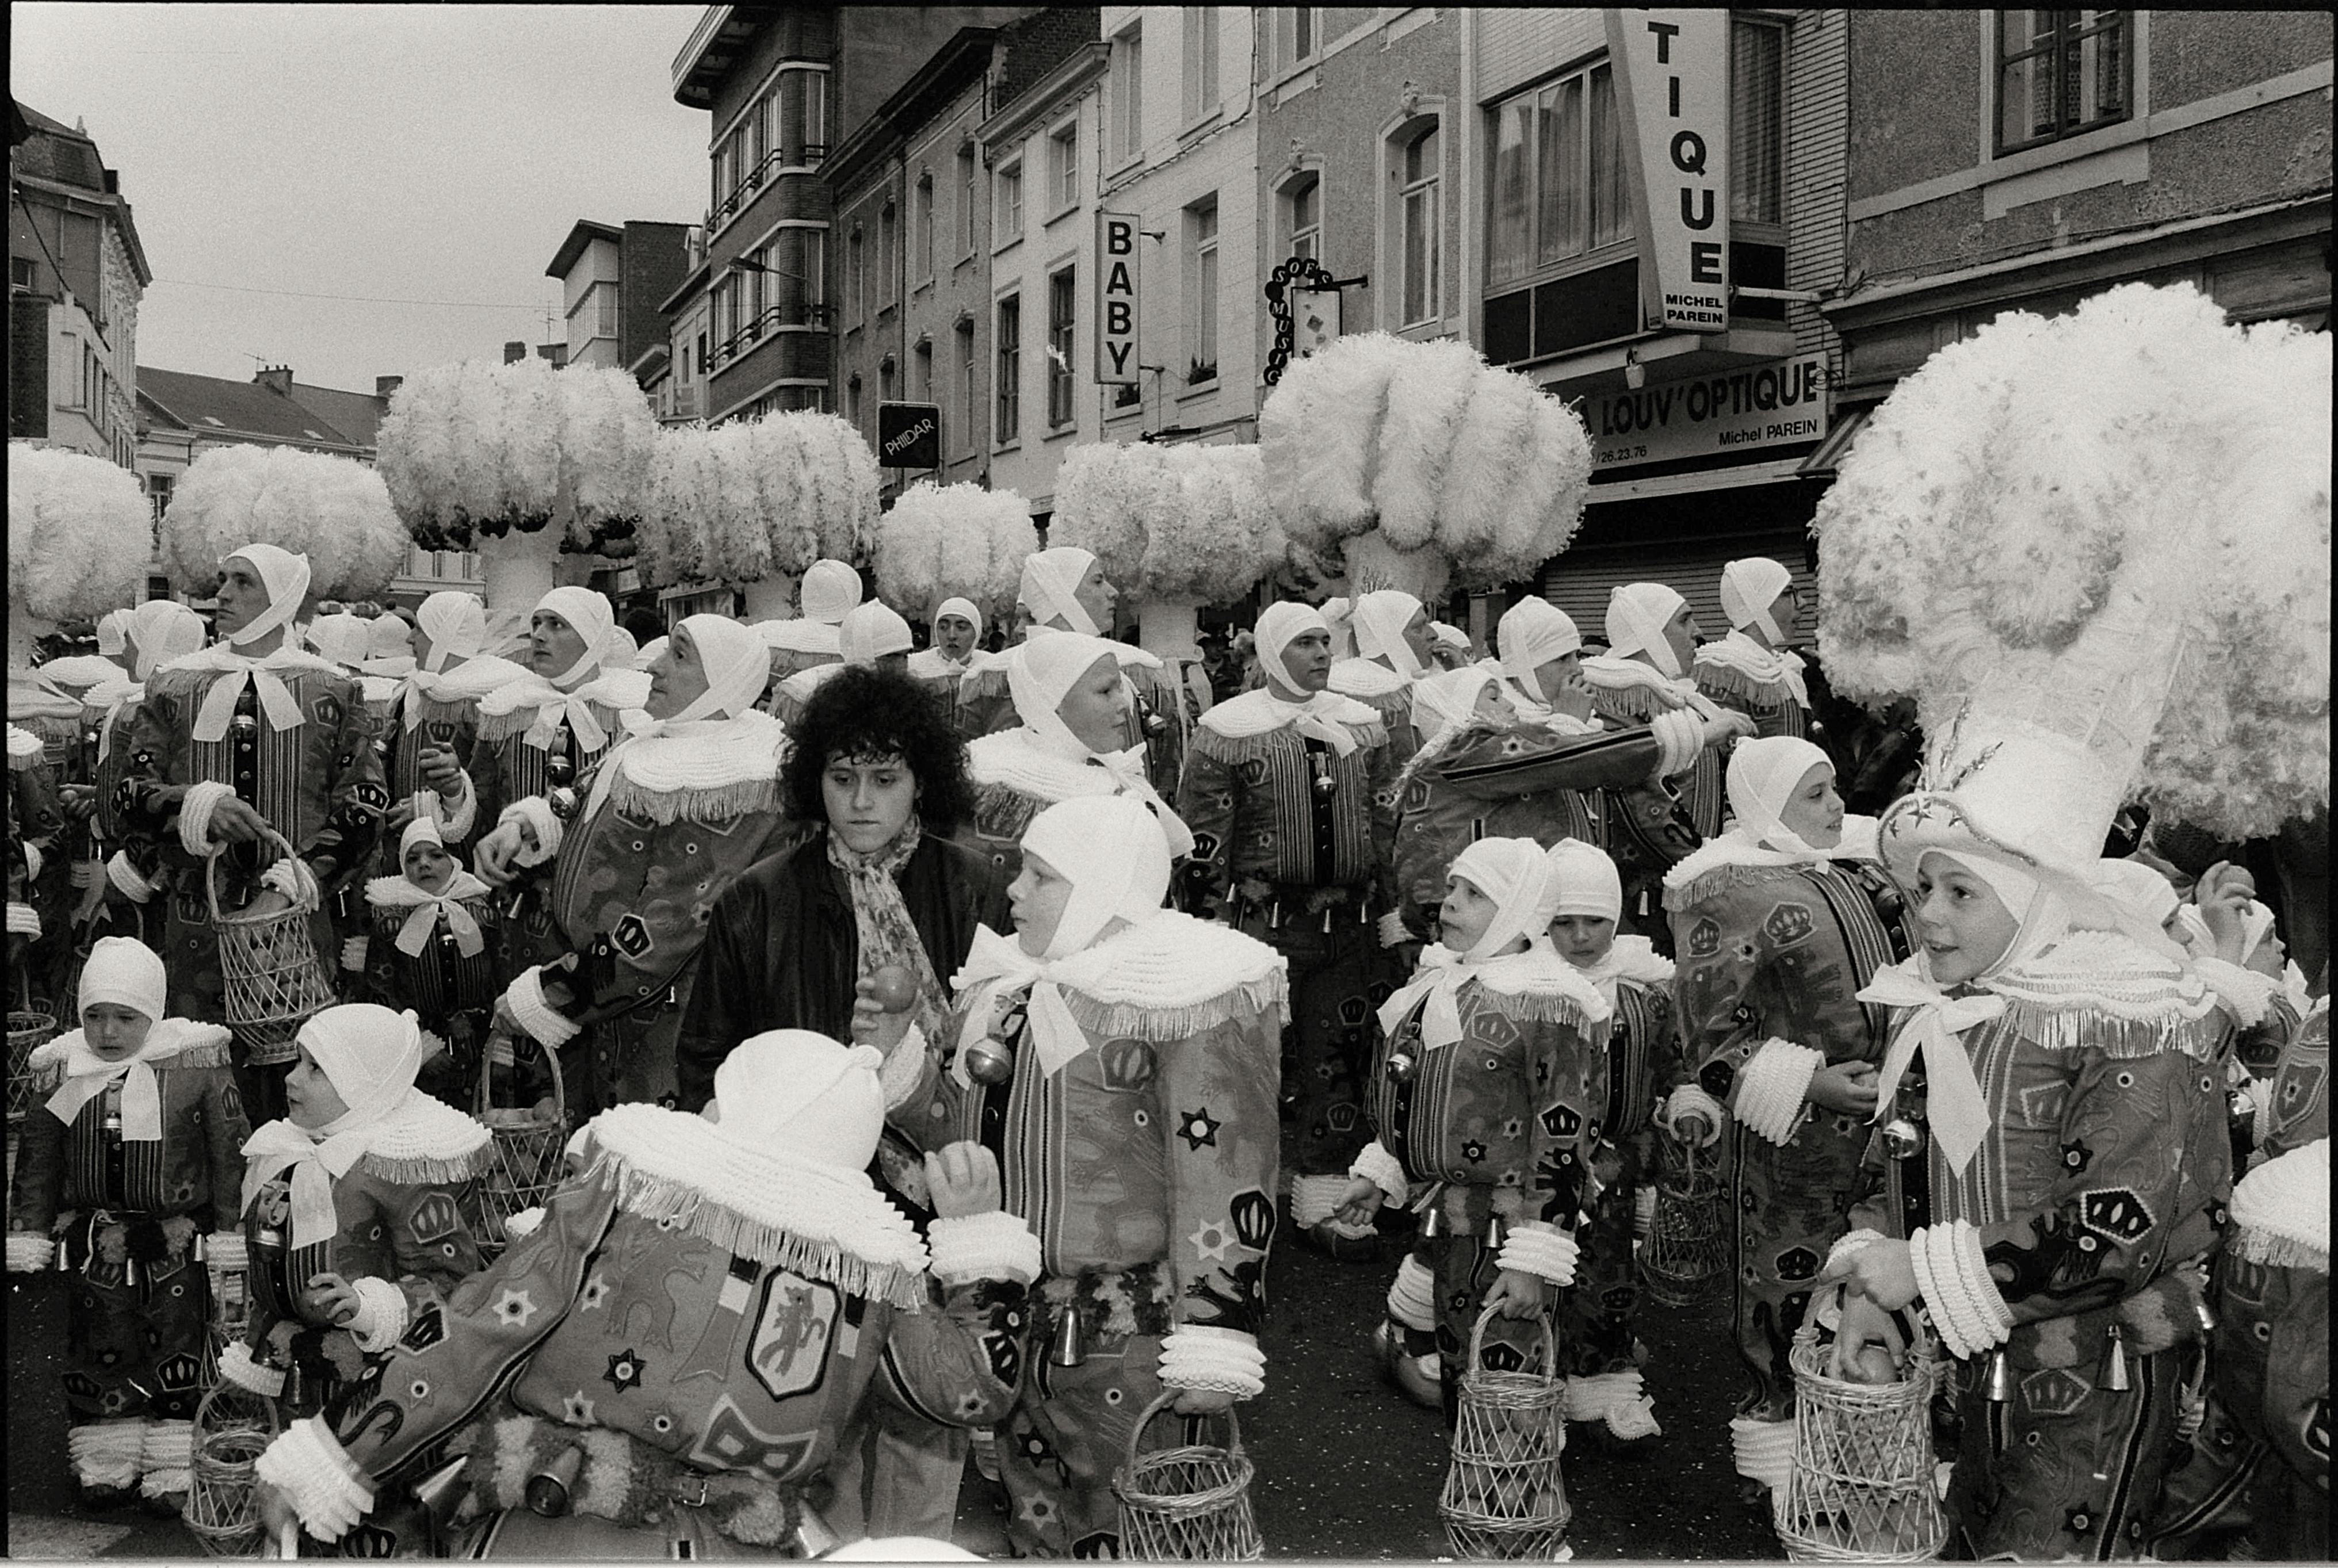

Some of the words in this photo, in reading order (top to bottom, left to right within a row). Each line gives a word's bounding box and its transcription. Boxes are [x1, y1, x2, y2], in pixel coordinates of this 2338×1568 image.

[1641, 9, 1723, 284] TIQUE
[1106, 221, 1133, 375] BABY
[1665, 294, 1723, 309] MICHEL
[1667, 309, 1723, 324] PAREIN
[1268, 303, 1289, 383] MUSIC
[1719, 427, 1761, 446] Michel
[1766, 419, 1817, 439] PAREIN
